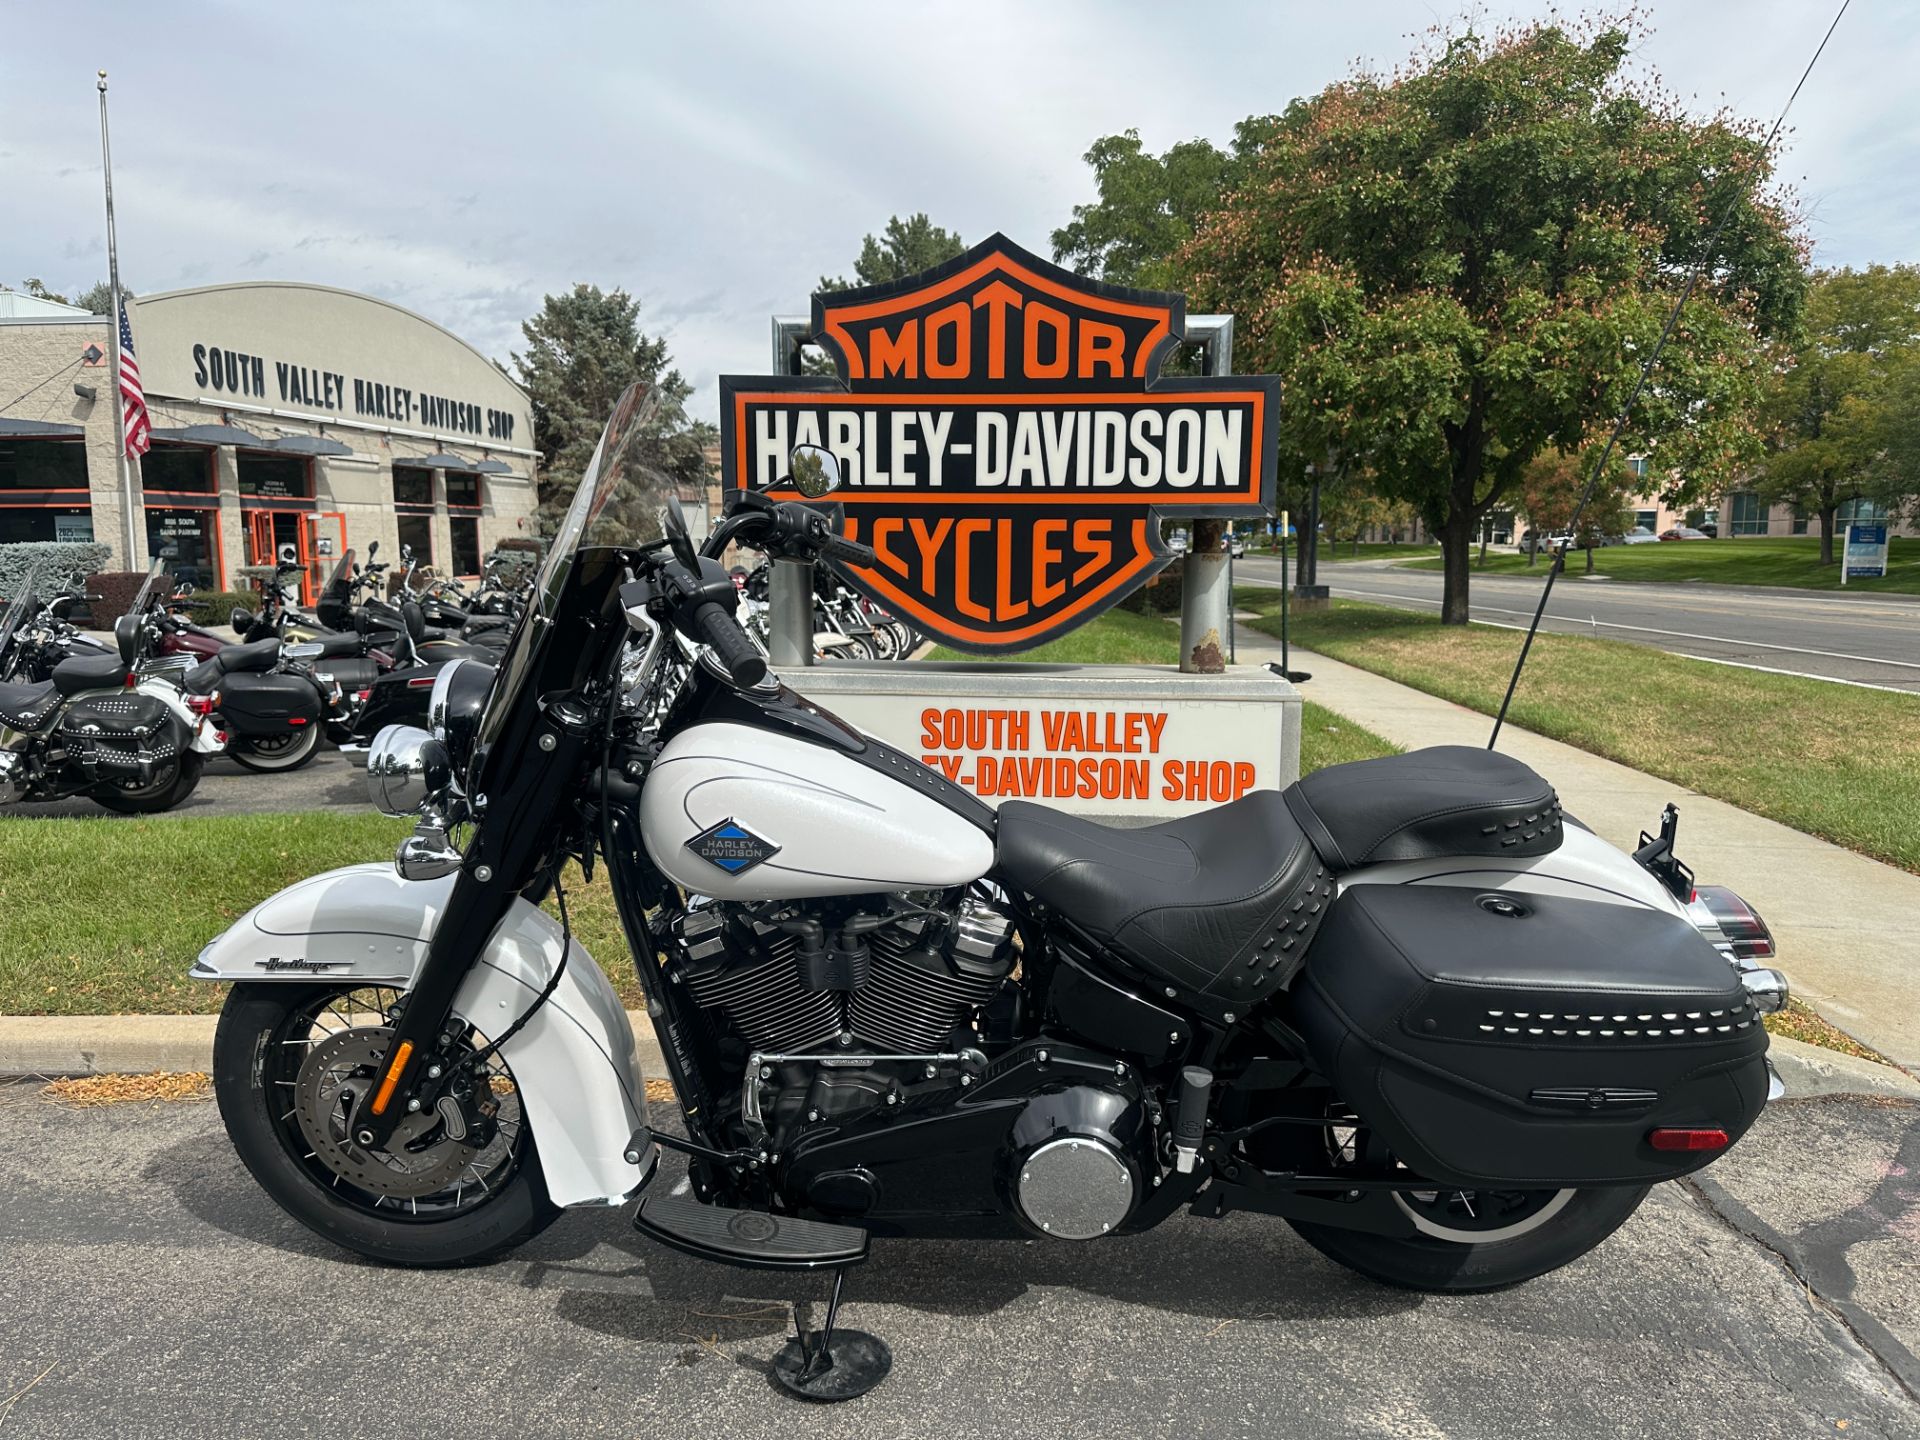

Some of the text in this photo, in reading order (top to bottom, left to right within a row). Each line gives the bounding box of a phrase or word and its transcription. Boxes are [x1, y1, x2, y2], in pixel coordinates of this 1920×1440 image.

[869, 280, 1125, 379] MOTOR
[193, 343, 515, 441] SOUTH VALLEY HARLEY-DAVIDSON SHOP
[873, 518, 1112, 622] CYCLES
[921, 708, 1168, 753] SOUTH VALLEY
[922, 755, 1256, 802] Y-DAVIDSON SHOP
[702, 848, 762, 857] DAVIDSON
[707, 840, 757, 849] HARLEY-
[265, 957, 331, 973] Heritage
